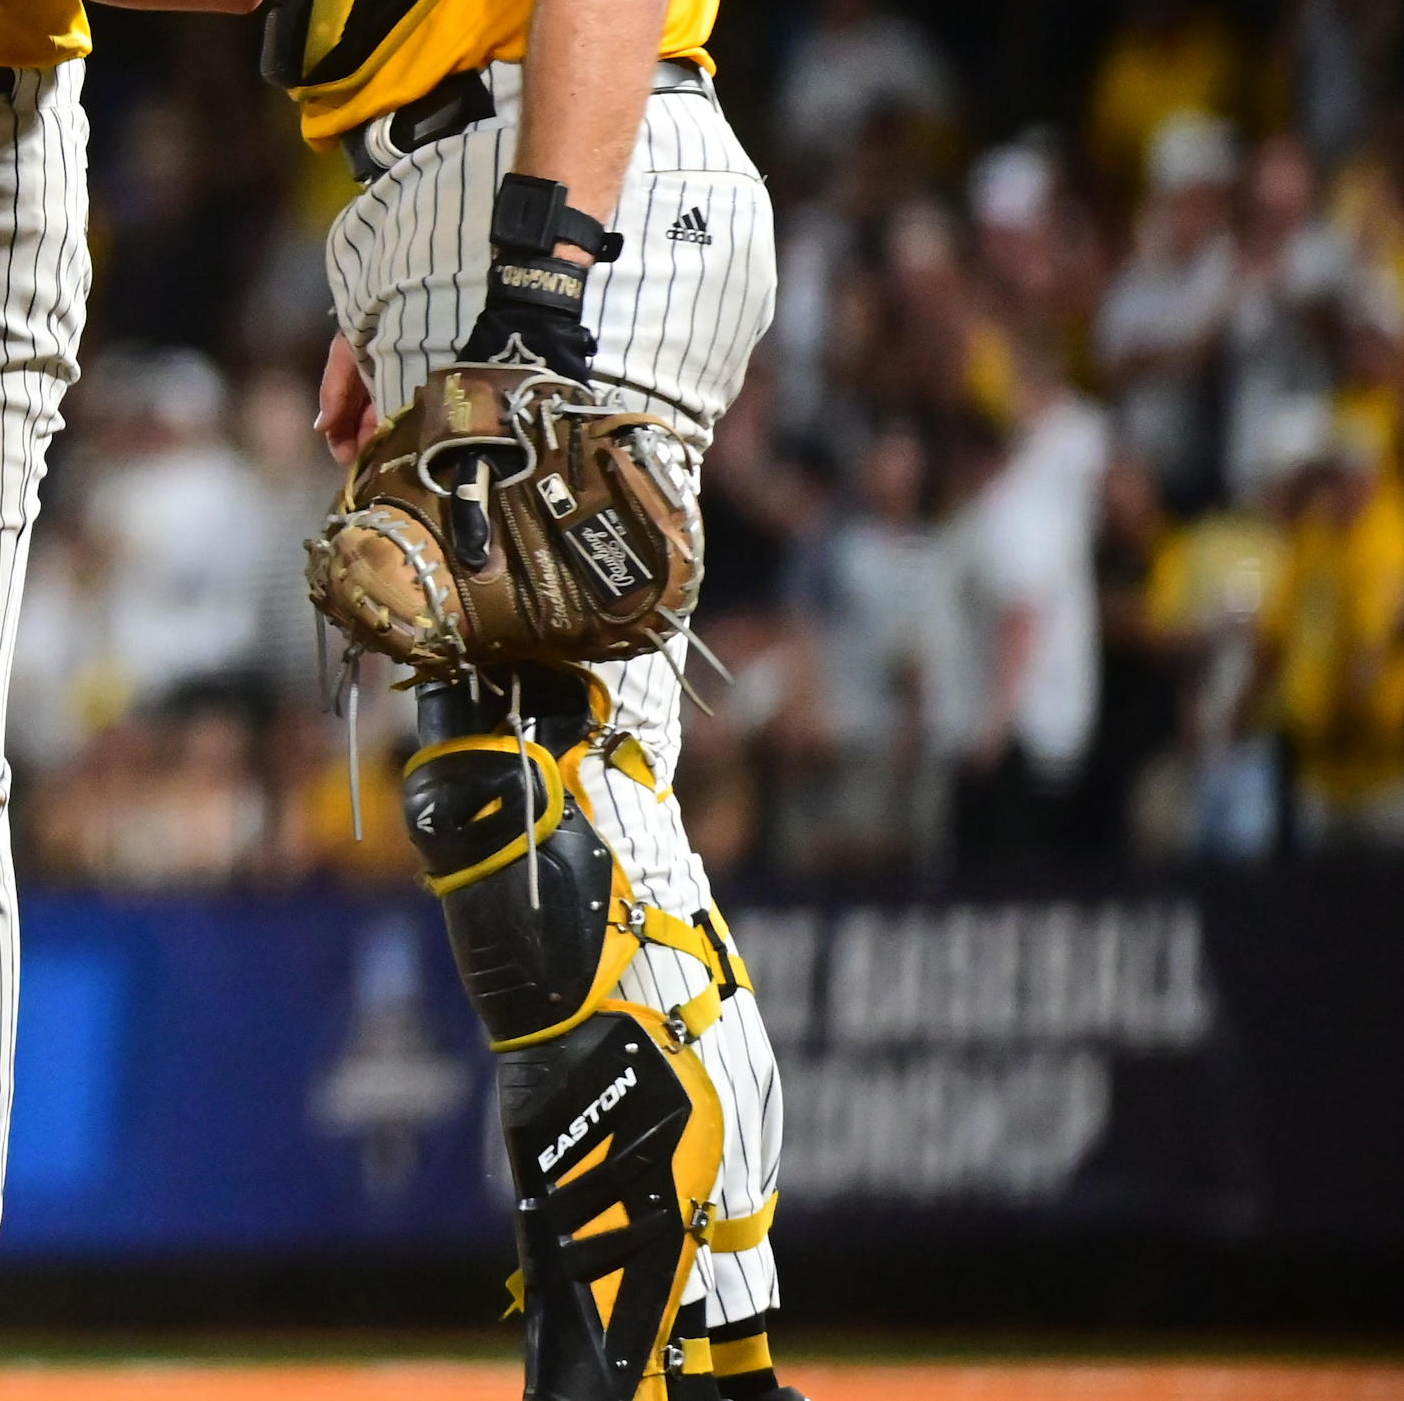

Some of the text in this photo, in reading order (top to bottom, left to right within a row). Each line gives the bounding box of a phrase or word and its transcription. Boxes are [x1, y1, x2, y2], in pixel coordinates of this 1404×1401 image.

[665, 228, 712, 245] adidas
[581, 526, 635, 587] Rawlings
[537, 1066, 638, 1174] EASTON
